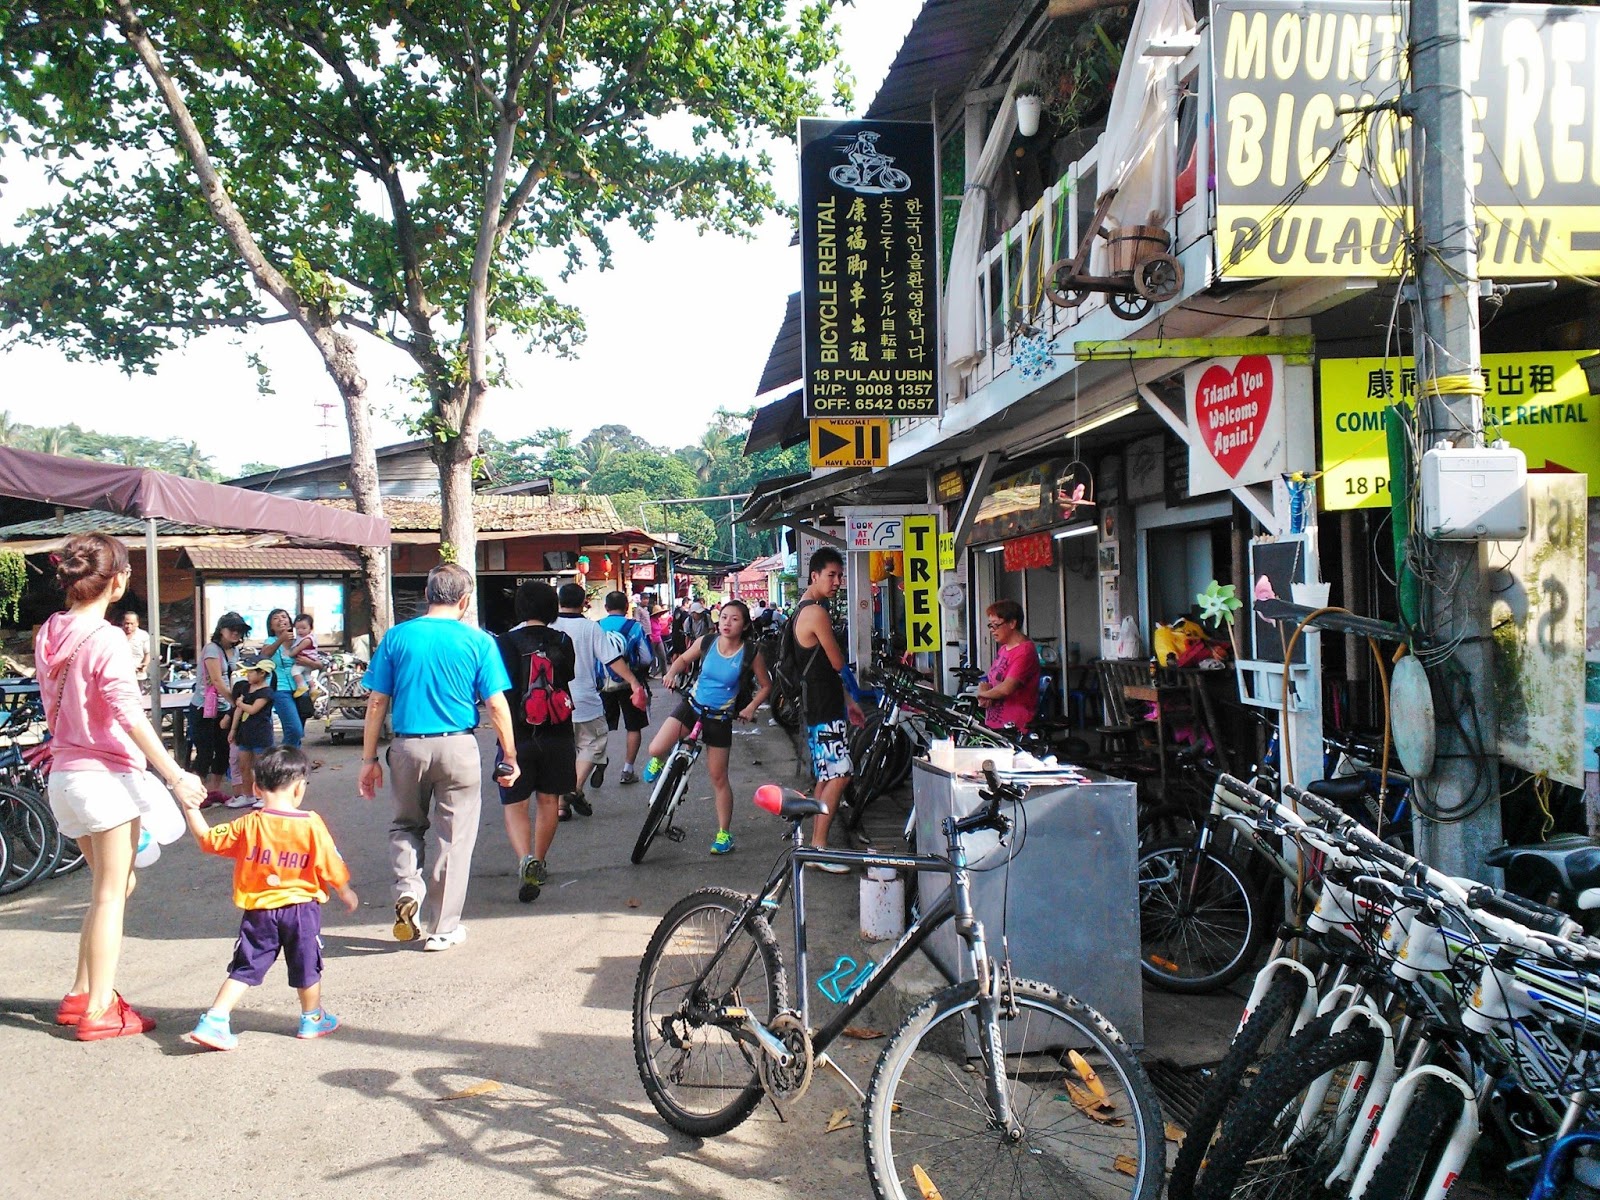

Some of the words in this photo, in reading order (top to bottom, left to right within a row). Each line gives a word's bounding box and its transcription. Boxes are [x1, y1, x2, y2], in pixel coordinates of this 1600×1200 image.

[1227, 93, 1487, 187] BICYCE
[818, 196, 837, 275] RENTAL
[1476, 217, 1552, 264] BIN
[819, 281, 839, 362] BICYCLE
[813, 369, 830, 381] 18
[834, 369, 891, 381] PULAU
[895, 369, 933, 381] UBIN
[813, 384, 846, 395] H/P:
[855, 384, 893, 395] 9008
[898, 384, 933, 395] 1357
[1203, 377, 1238, 407] Thank
[1241, 372, 1264, 398] You
[814, 399, 851, 410] OFF:
[855, 398, 893, 410] 6542
[897, 398, 935, 410] 0557
[1209, 401, 1258, 429] Welcome
[1517, 403, 1588, 425] RENTAL
[1214, 421, 1254, 458] Again!
[1345, 477, 1368, 495] 18
[857, 530, 868, 538] AT
[909, 526, 934, 647] TREK
[246, 845, 271, 865] JIA
[277, 851, 310, 870] HAO
